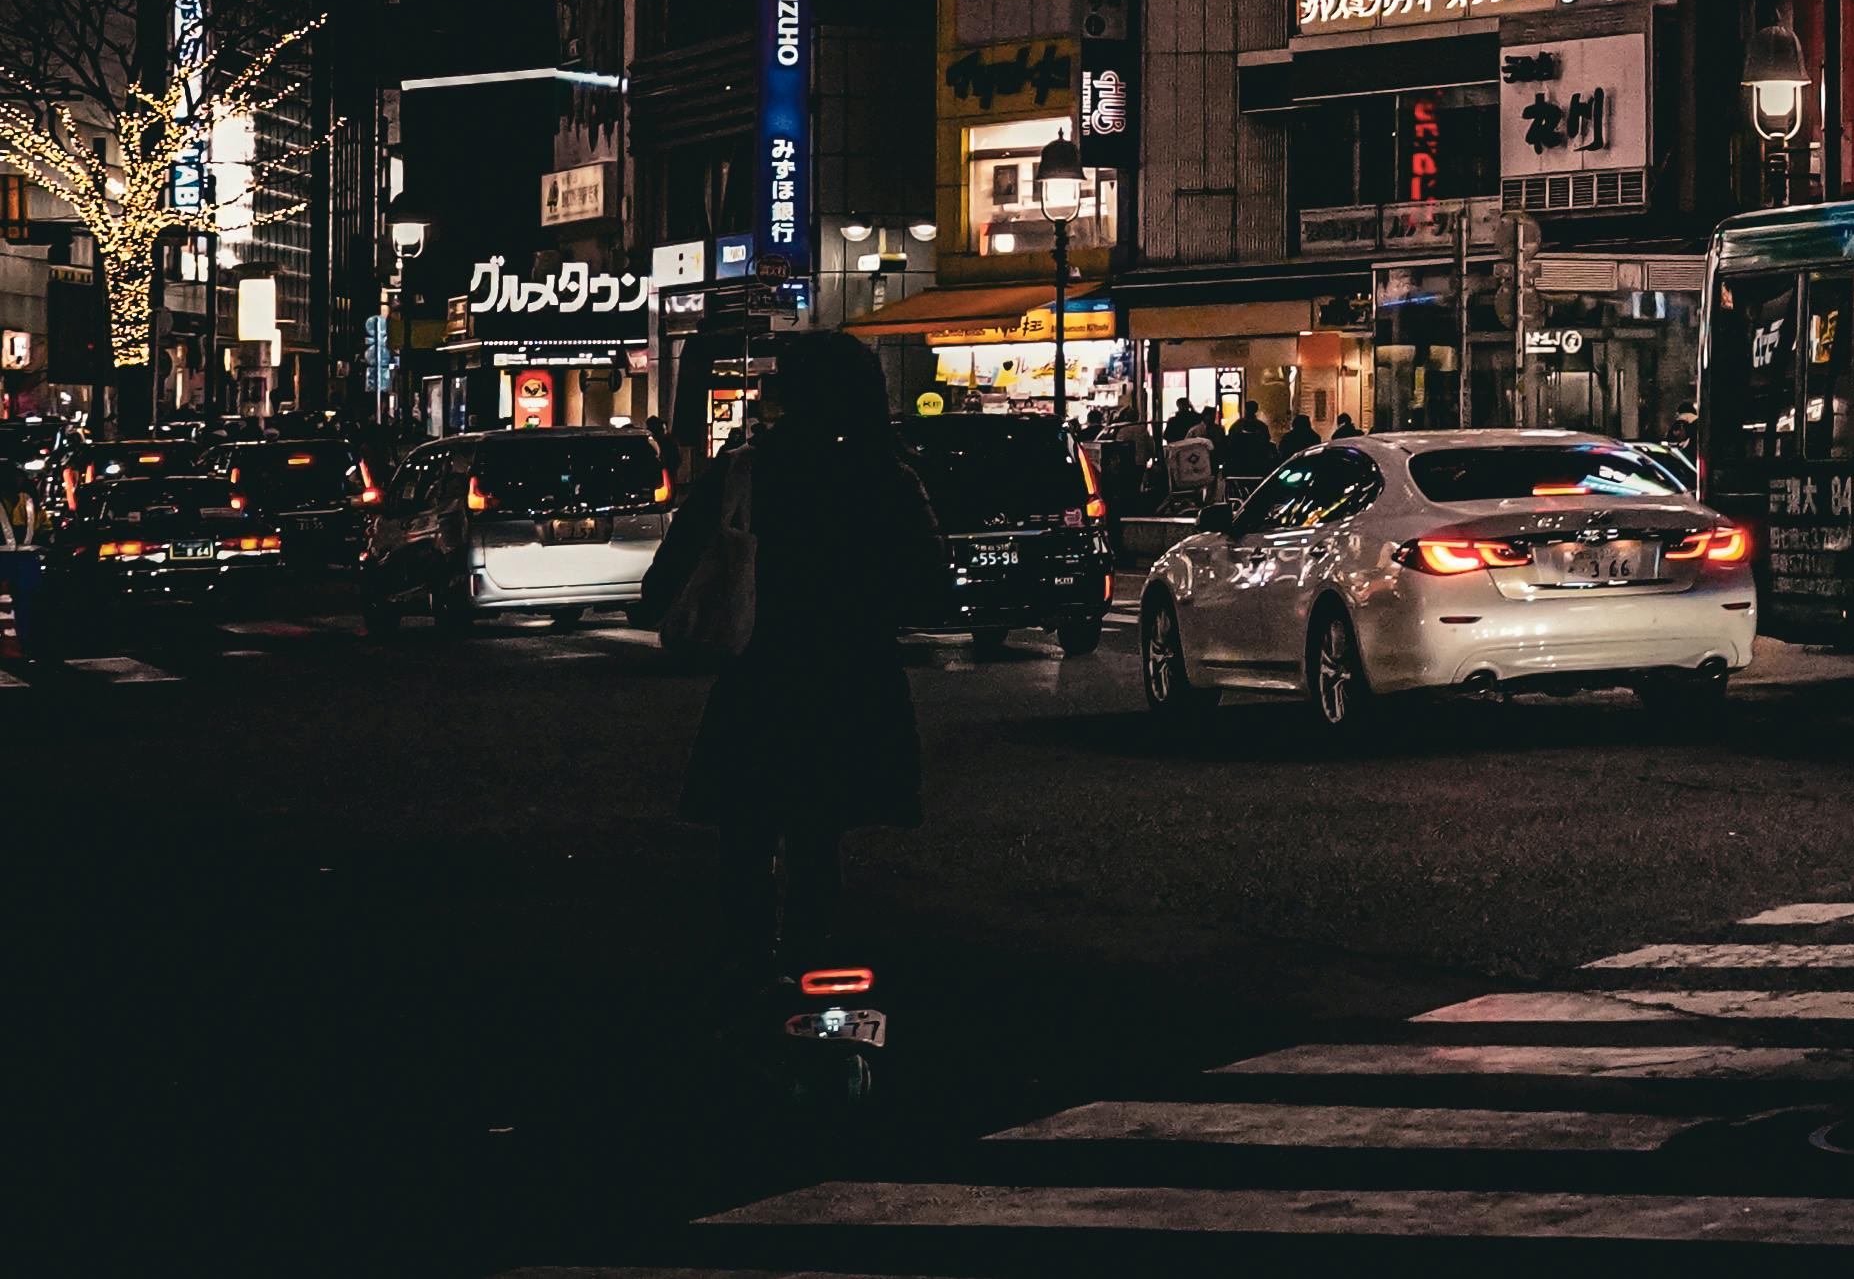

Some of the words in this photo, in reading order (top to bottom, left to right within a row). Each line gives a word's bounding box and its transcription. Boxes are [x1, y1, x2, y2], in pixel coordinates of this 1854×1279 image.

[771, 138, 796, 244] みずほ銀行
[468, 255, 650, 314] グルメタウン
